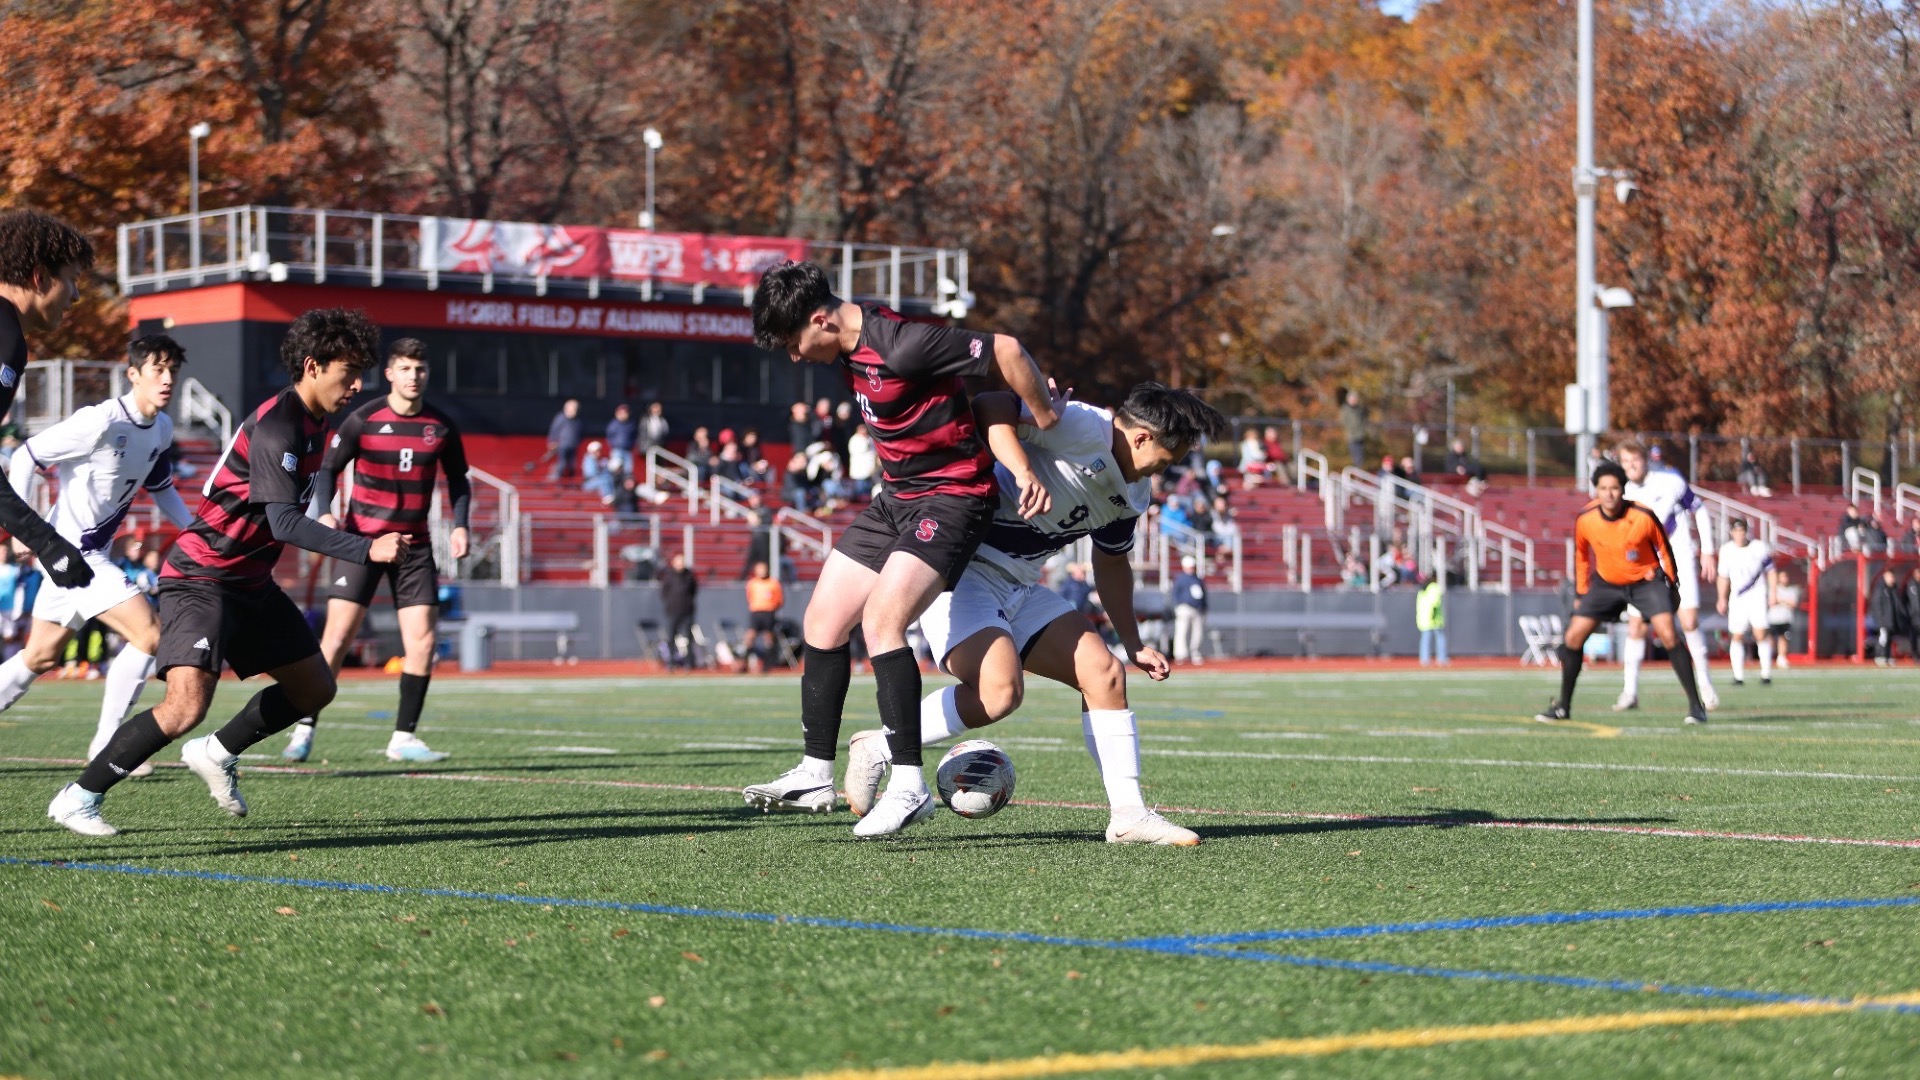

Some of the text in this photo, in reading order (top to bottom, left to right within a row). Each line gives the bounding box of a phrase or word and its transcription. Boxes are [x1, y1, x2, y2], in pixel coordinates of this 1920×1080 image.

[609, 241, 684, 270] WPI
[518, 303, 576, 329] FIELD
[577, 307, 604, 329] AT
[605, 309, 684, 334] ALUMNI
[685, 313, 754, 338] STADIU
[866, 366, 882, 392] S
[423, 425, 437, 446] S
[399, 448, 413, 472] 8
[118, 479, 138, 503] 7
[1057, 505, 1089, 529] 9
[915, 519, 938, 542] S
